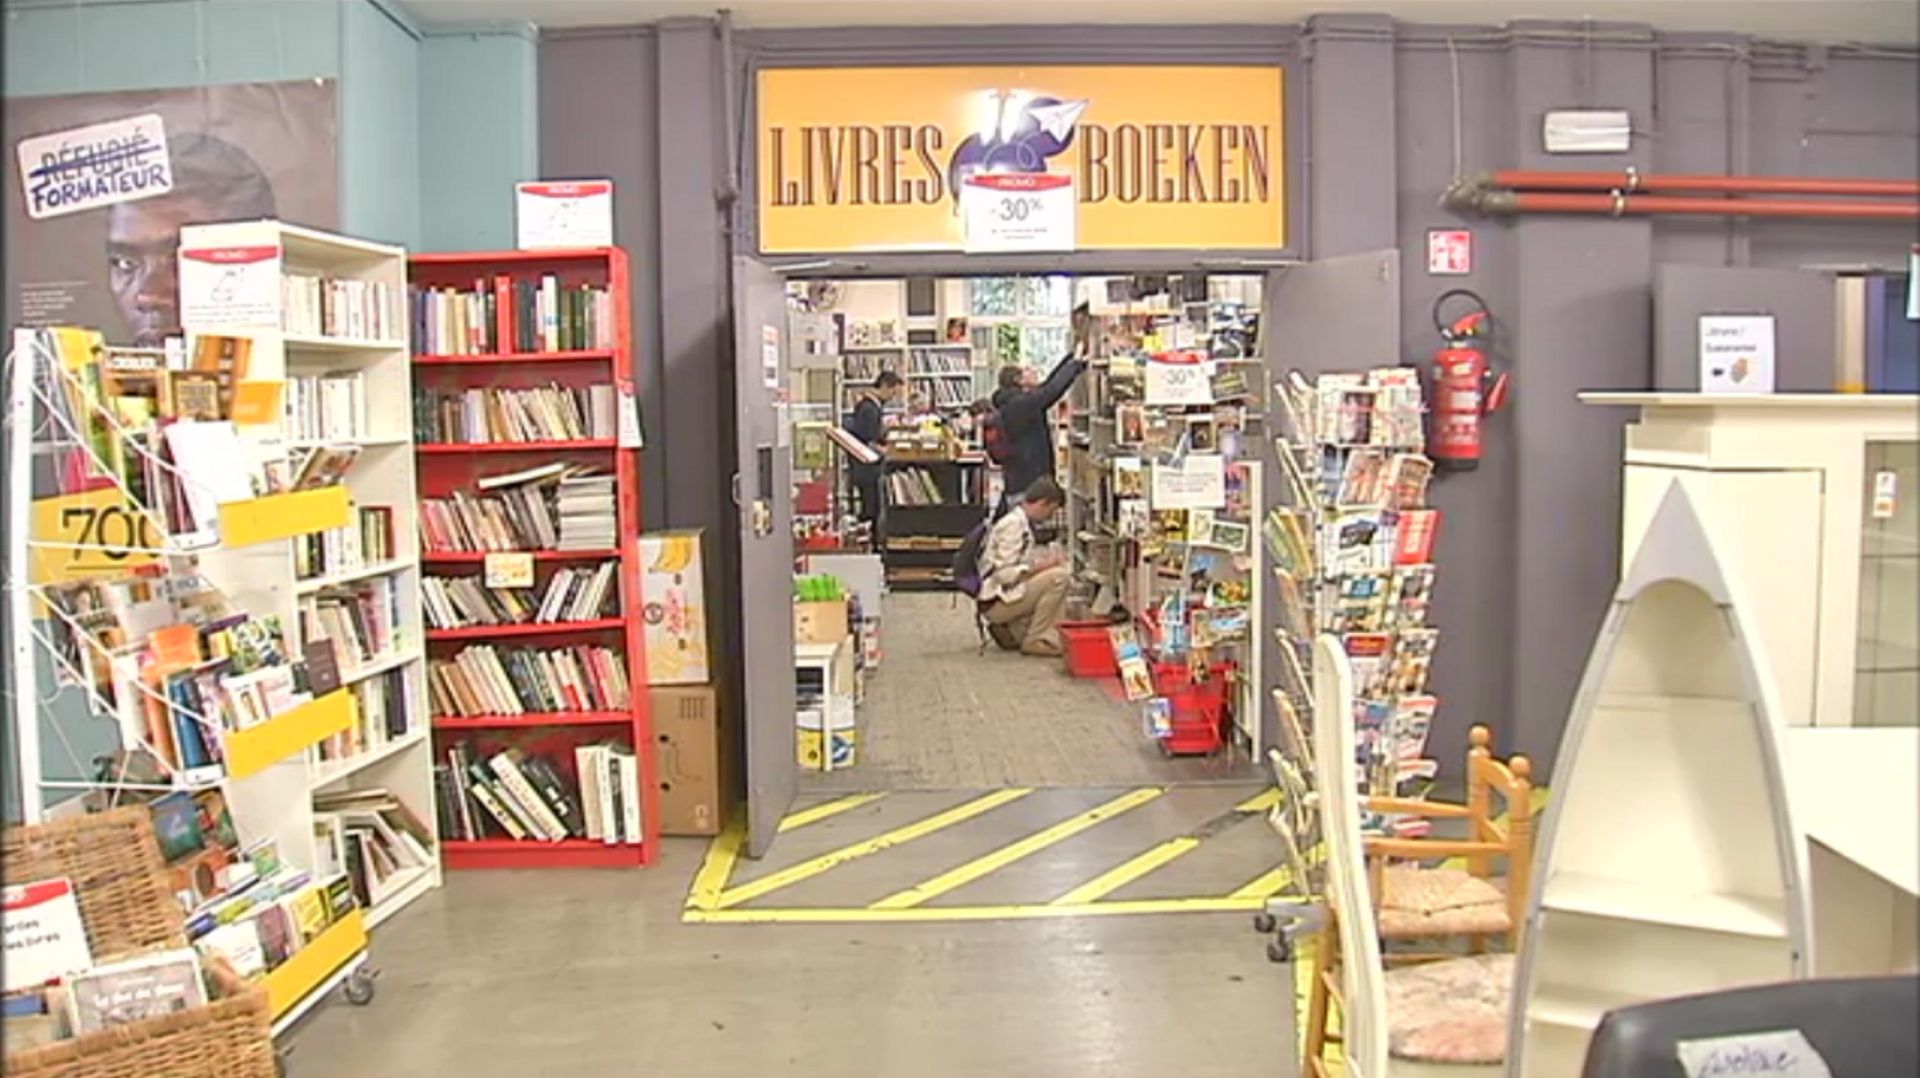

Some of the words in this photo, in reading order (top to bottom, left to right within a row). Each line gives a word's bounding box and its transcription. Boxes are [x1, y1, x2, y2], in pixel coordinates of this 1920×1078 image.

[30, 163, 169, 213] FORMATEUR
[769, 125, 944, 206] LIVRES
[1079, 124, 1269, 204] BOEKEN
